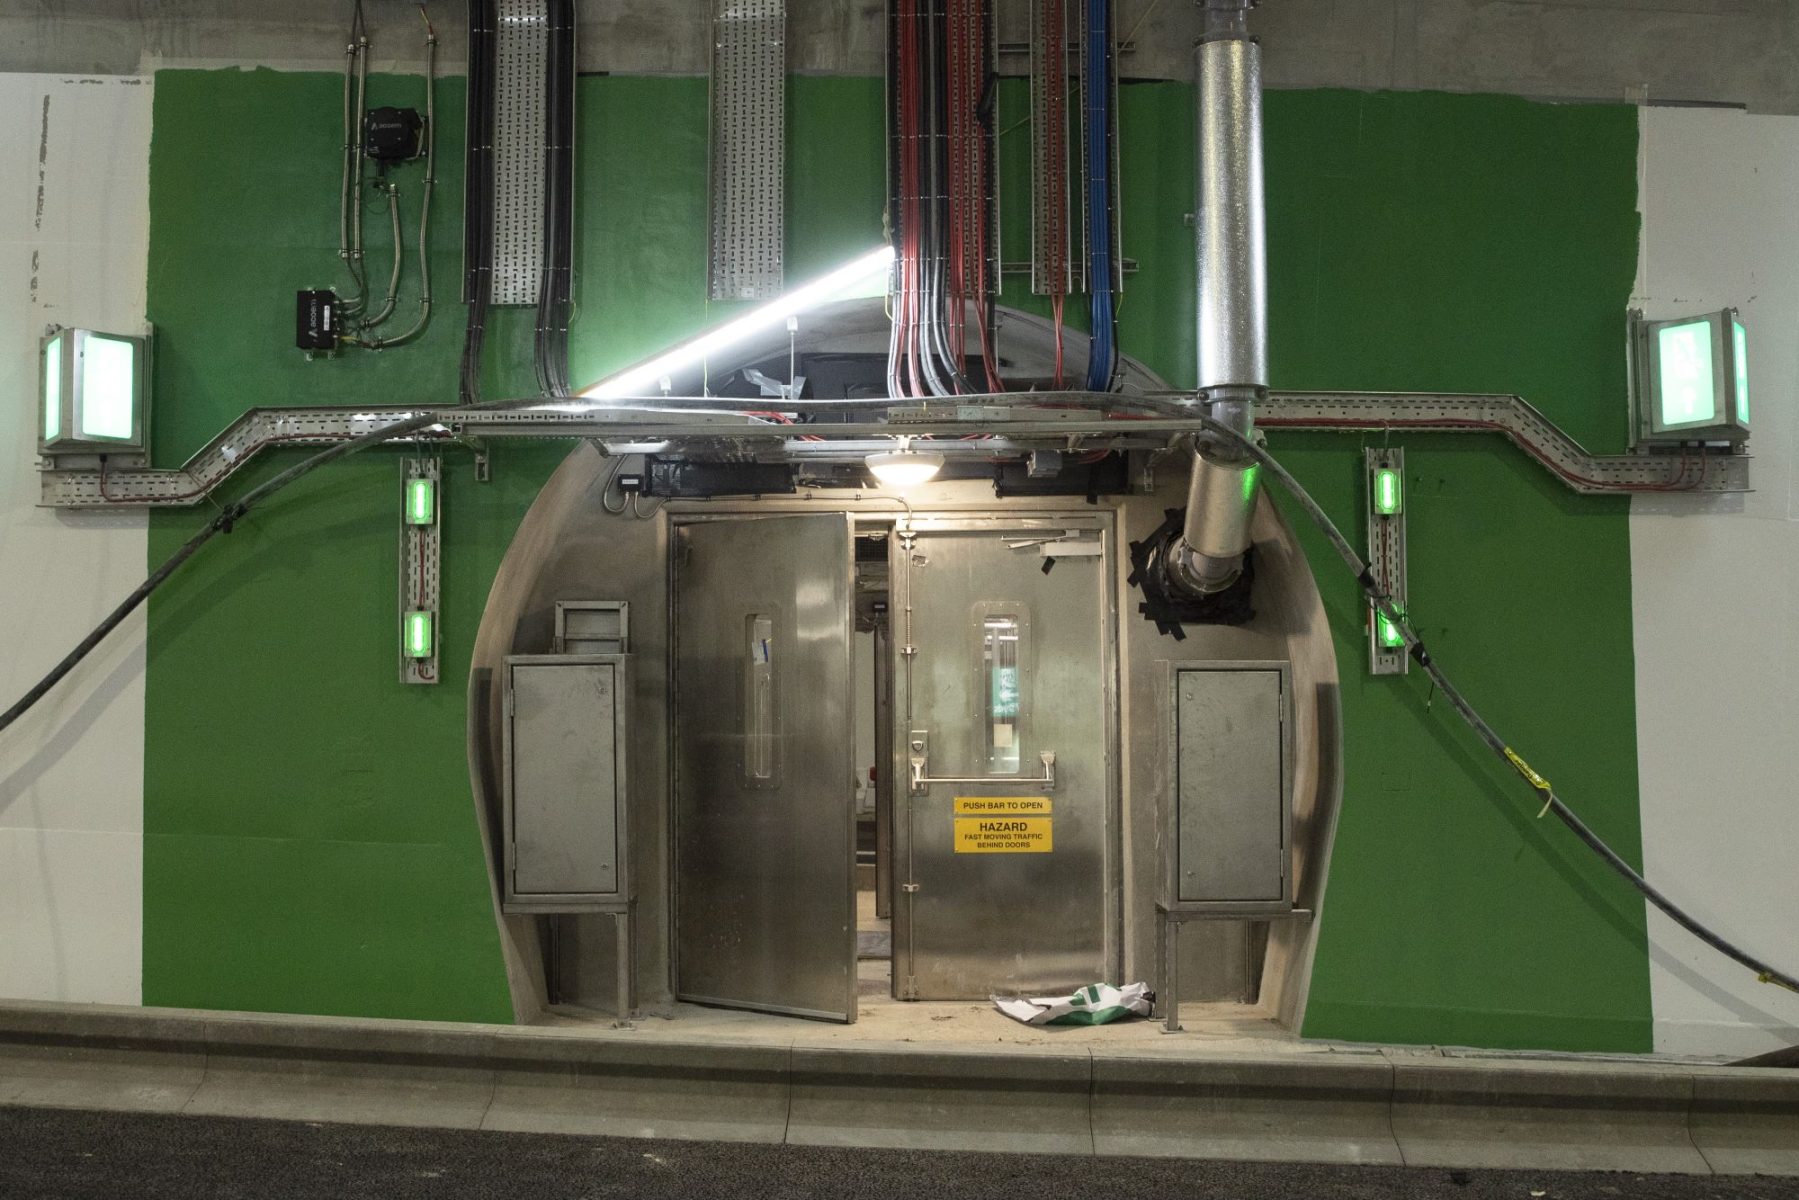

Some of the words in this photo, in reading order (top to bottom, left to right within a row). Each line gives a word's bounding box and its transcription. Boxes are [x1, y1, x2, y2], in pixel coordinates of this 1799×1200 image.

[963, 802, 986, 810] PUSH
[987, 801, 1005, 810] BAR
[1007, 801, 1018, 809] TO
[1020, 801, 1043, 809] OPEN
[979, 822, 1028, 832] HAZARD
[1005, 841, 1031, 849] DOORS
